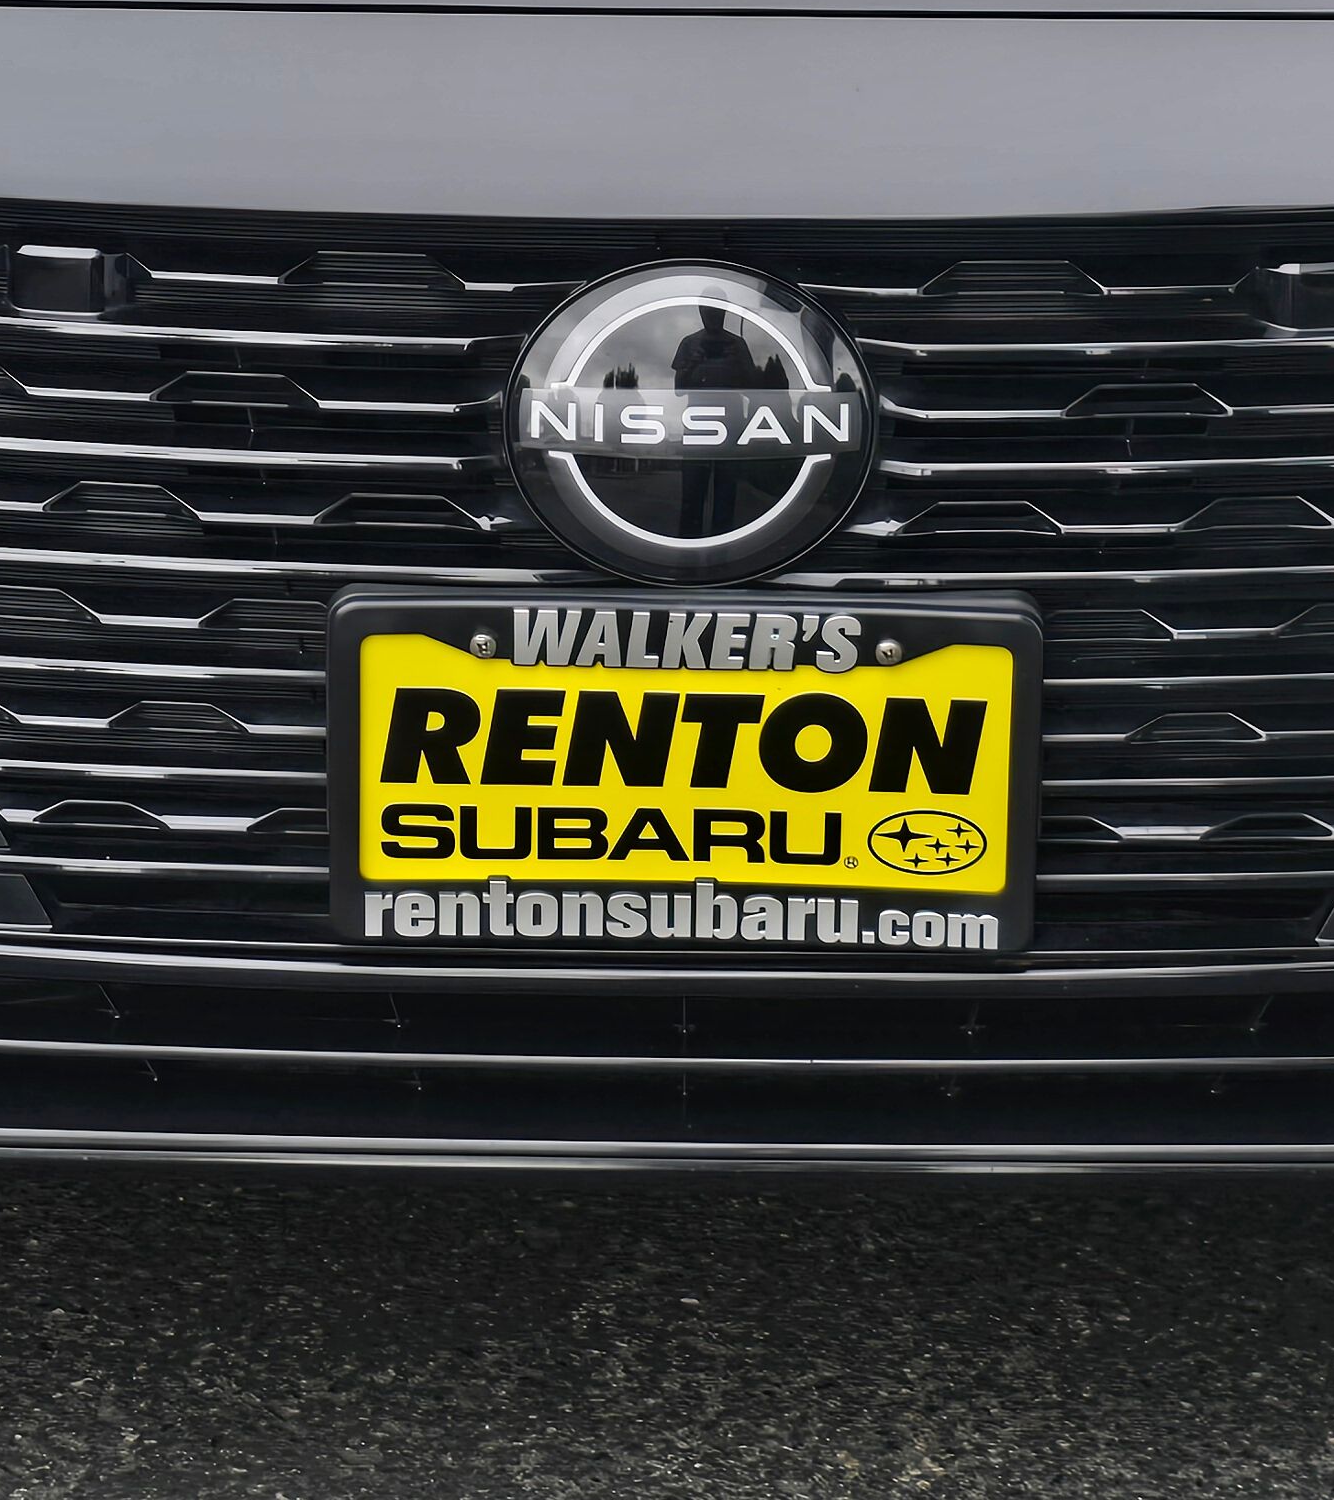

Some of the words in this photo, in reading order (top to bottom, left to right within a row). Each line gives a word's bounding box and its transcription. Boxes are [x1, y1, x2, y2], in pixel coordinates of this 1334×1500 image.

[530, 399, 850, 446] NISSAN
[512, 607, 864, 674] WALKER'S
[380, 687, 988, 795] RENTON
[380, 803, 842, 867] SUBARU
[363, 877, 1000, 951] rentonsubaru.com
